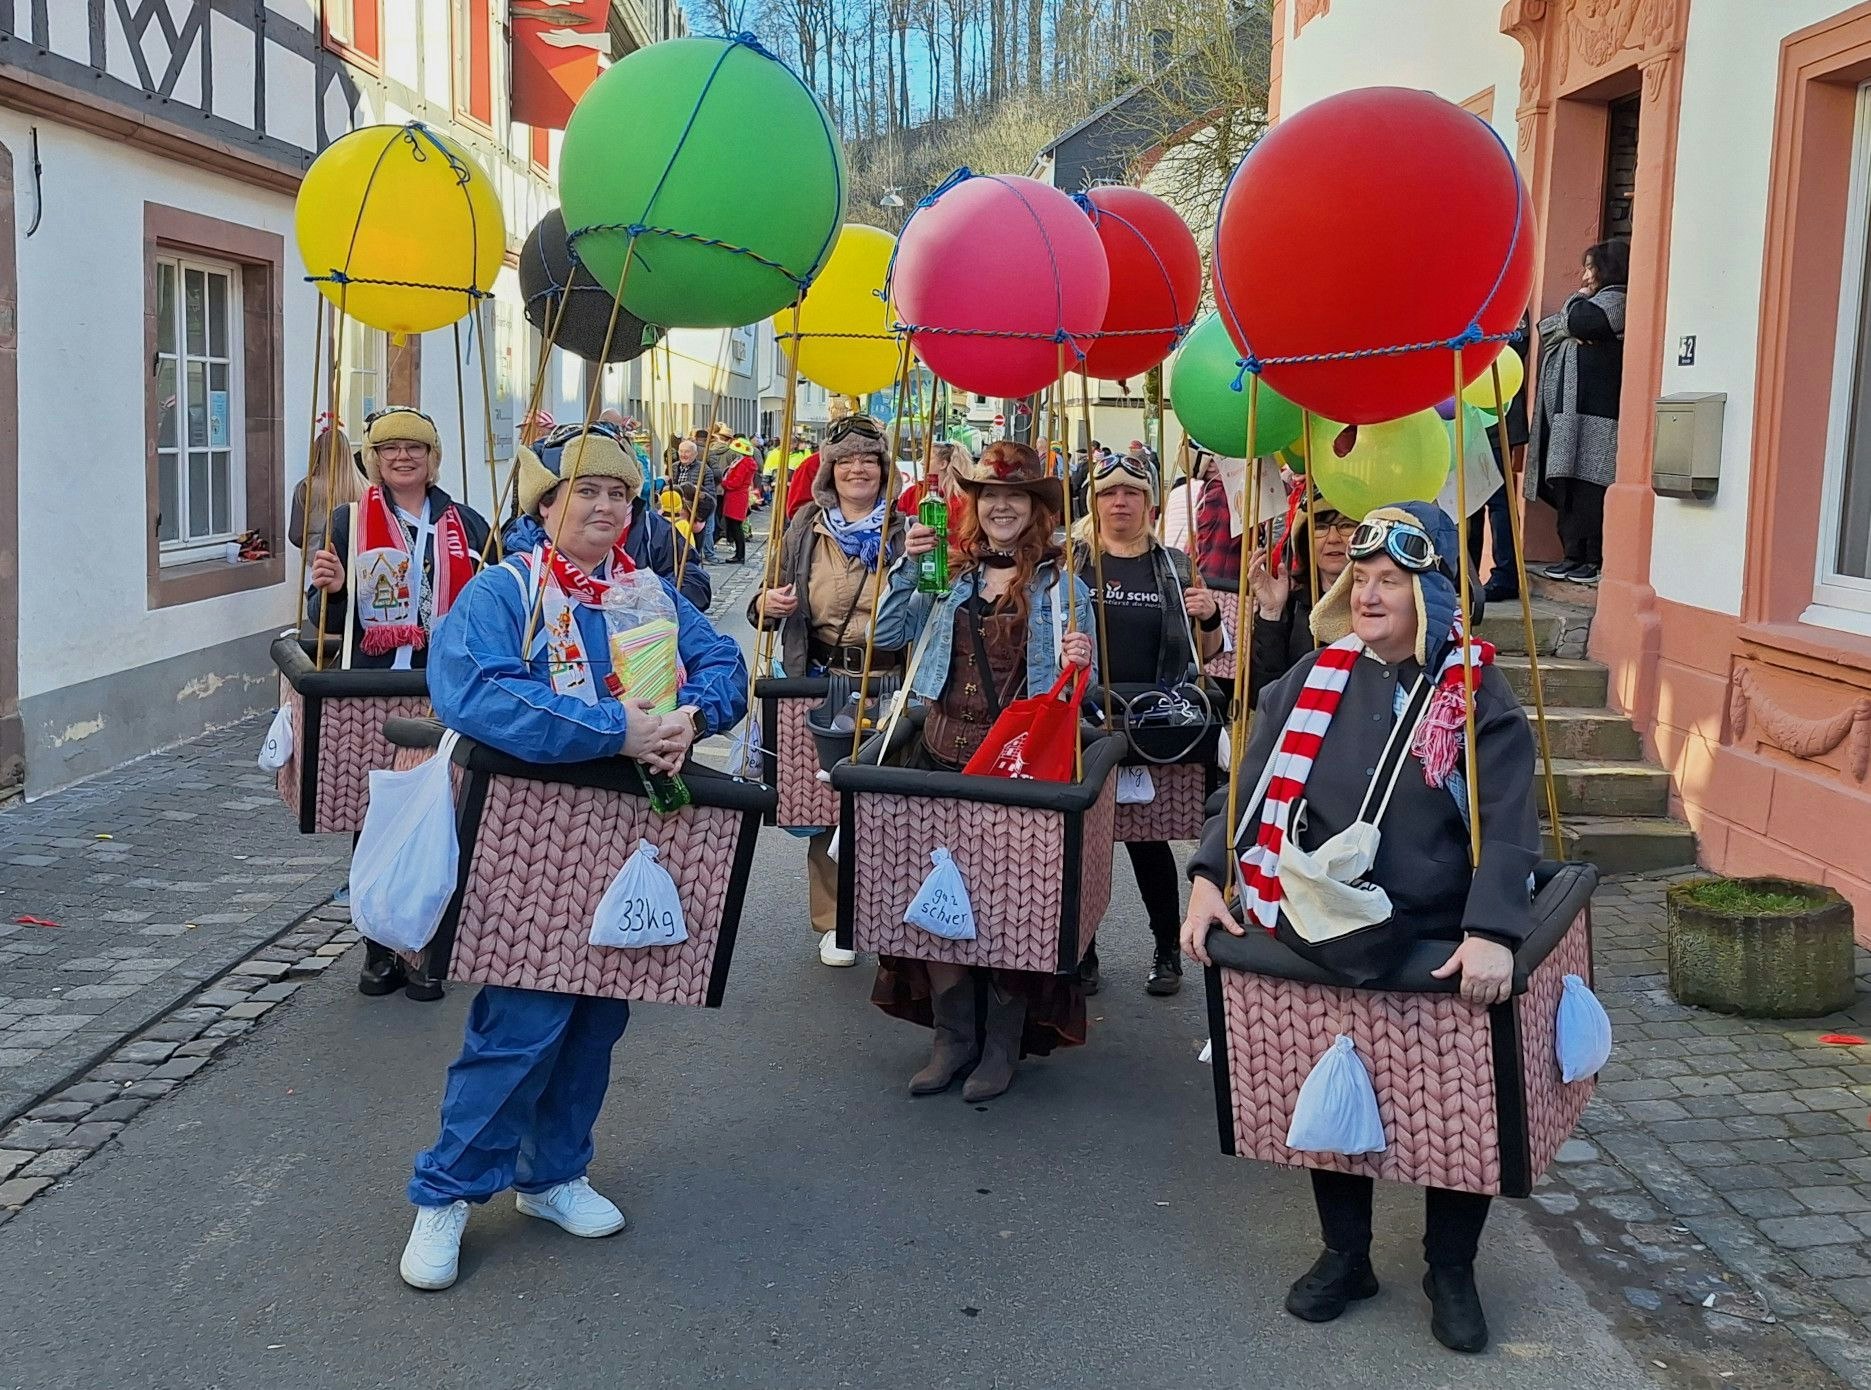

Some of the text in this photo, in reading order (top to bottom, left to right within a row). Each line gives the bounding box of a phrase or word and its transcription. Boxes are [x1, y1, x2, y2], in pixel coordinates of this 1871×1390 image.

[1106, 590, 1124, 600] DU
[1126, 591, 1162, 603] SCHO
[618, 897, 675, 937] 33kg
